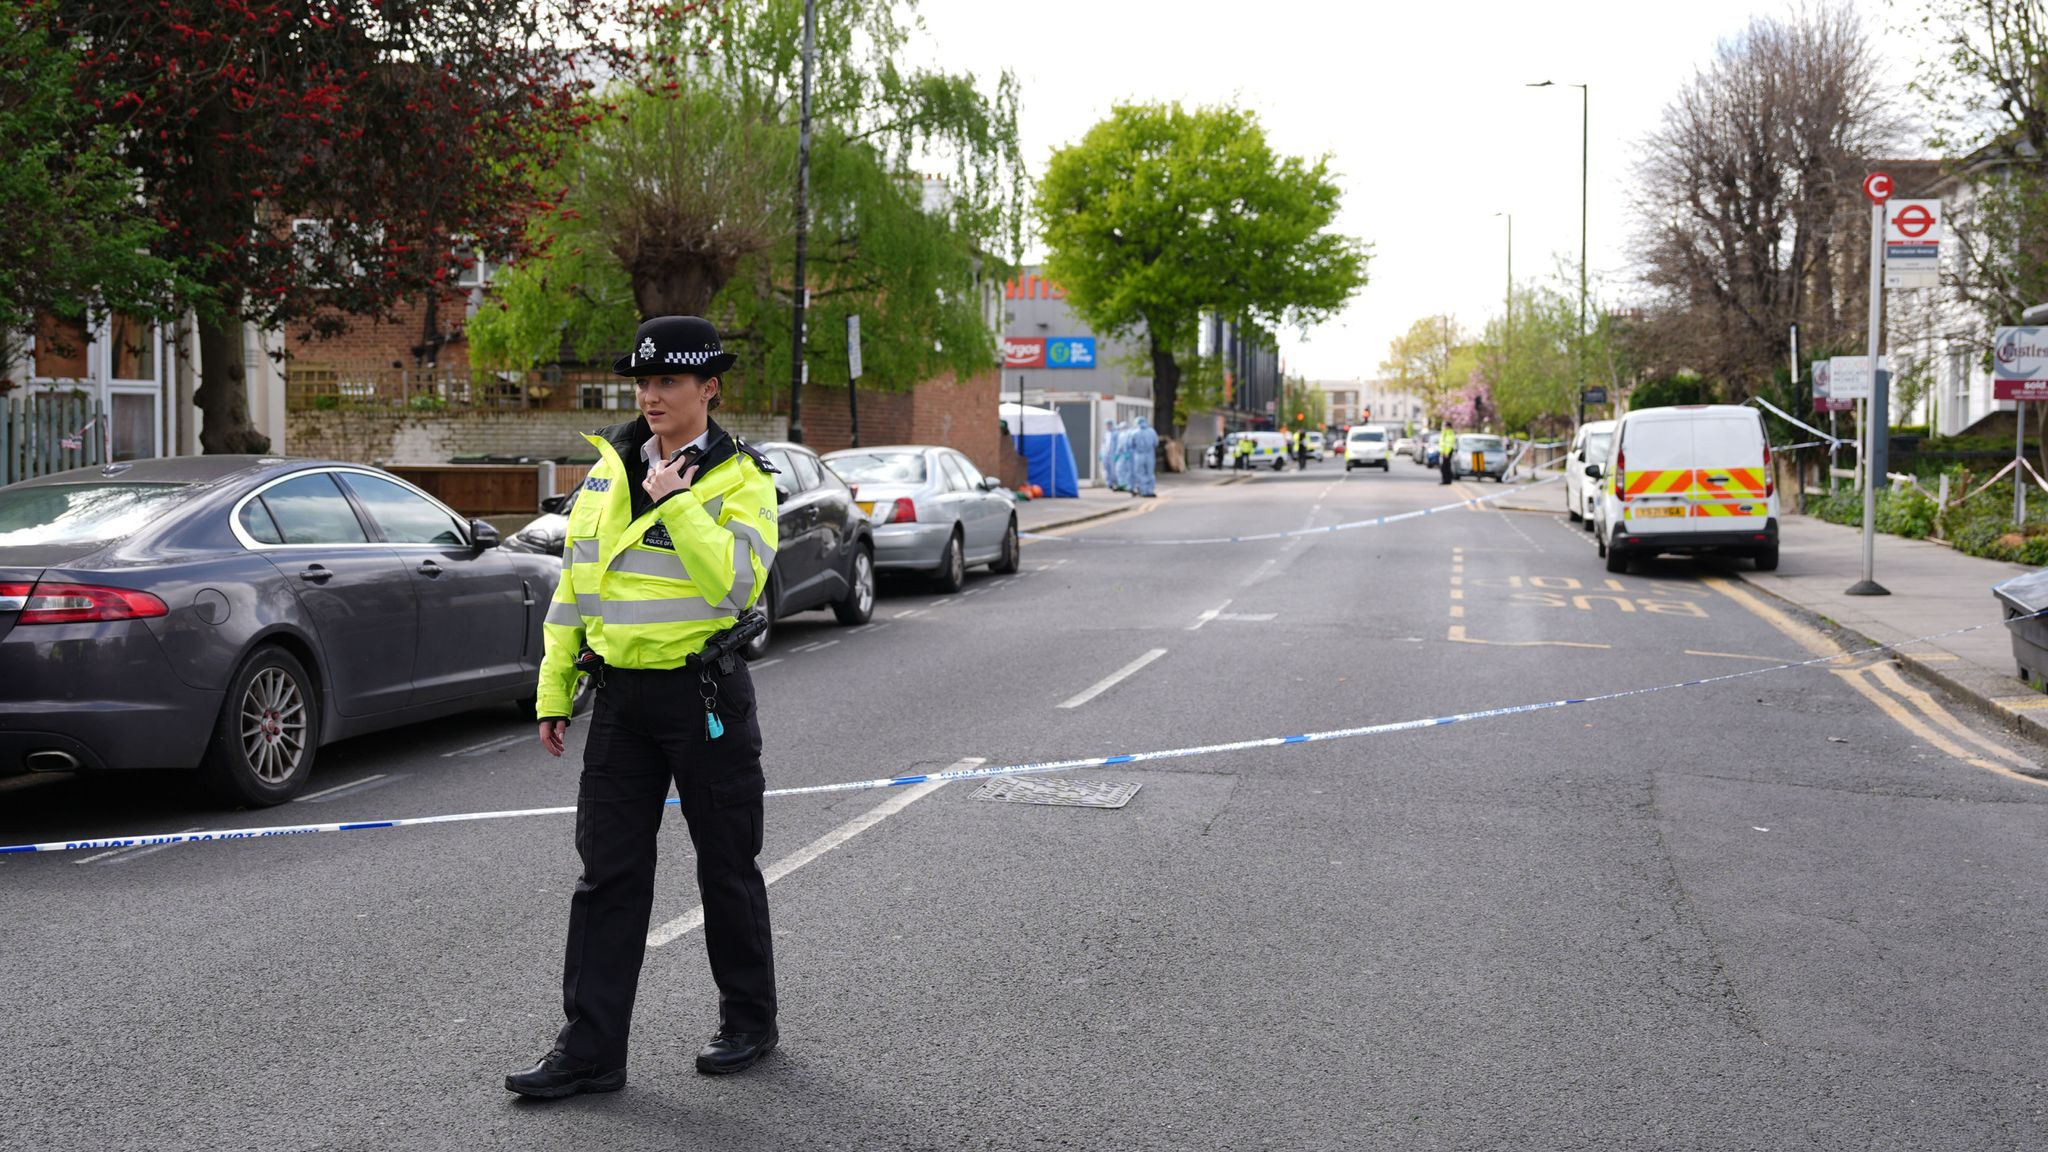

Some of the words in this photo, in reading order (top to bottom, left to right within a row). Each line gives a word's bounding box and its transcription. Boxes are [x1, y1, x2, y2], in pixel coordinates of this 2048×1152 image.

[1868, 175, 1889, 198] C
[1004, 341, 1041, 358] Argos
[645, 538, 664, 546] POLICE
[1508, 592, 1711, 619] BUS
